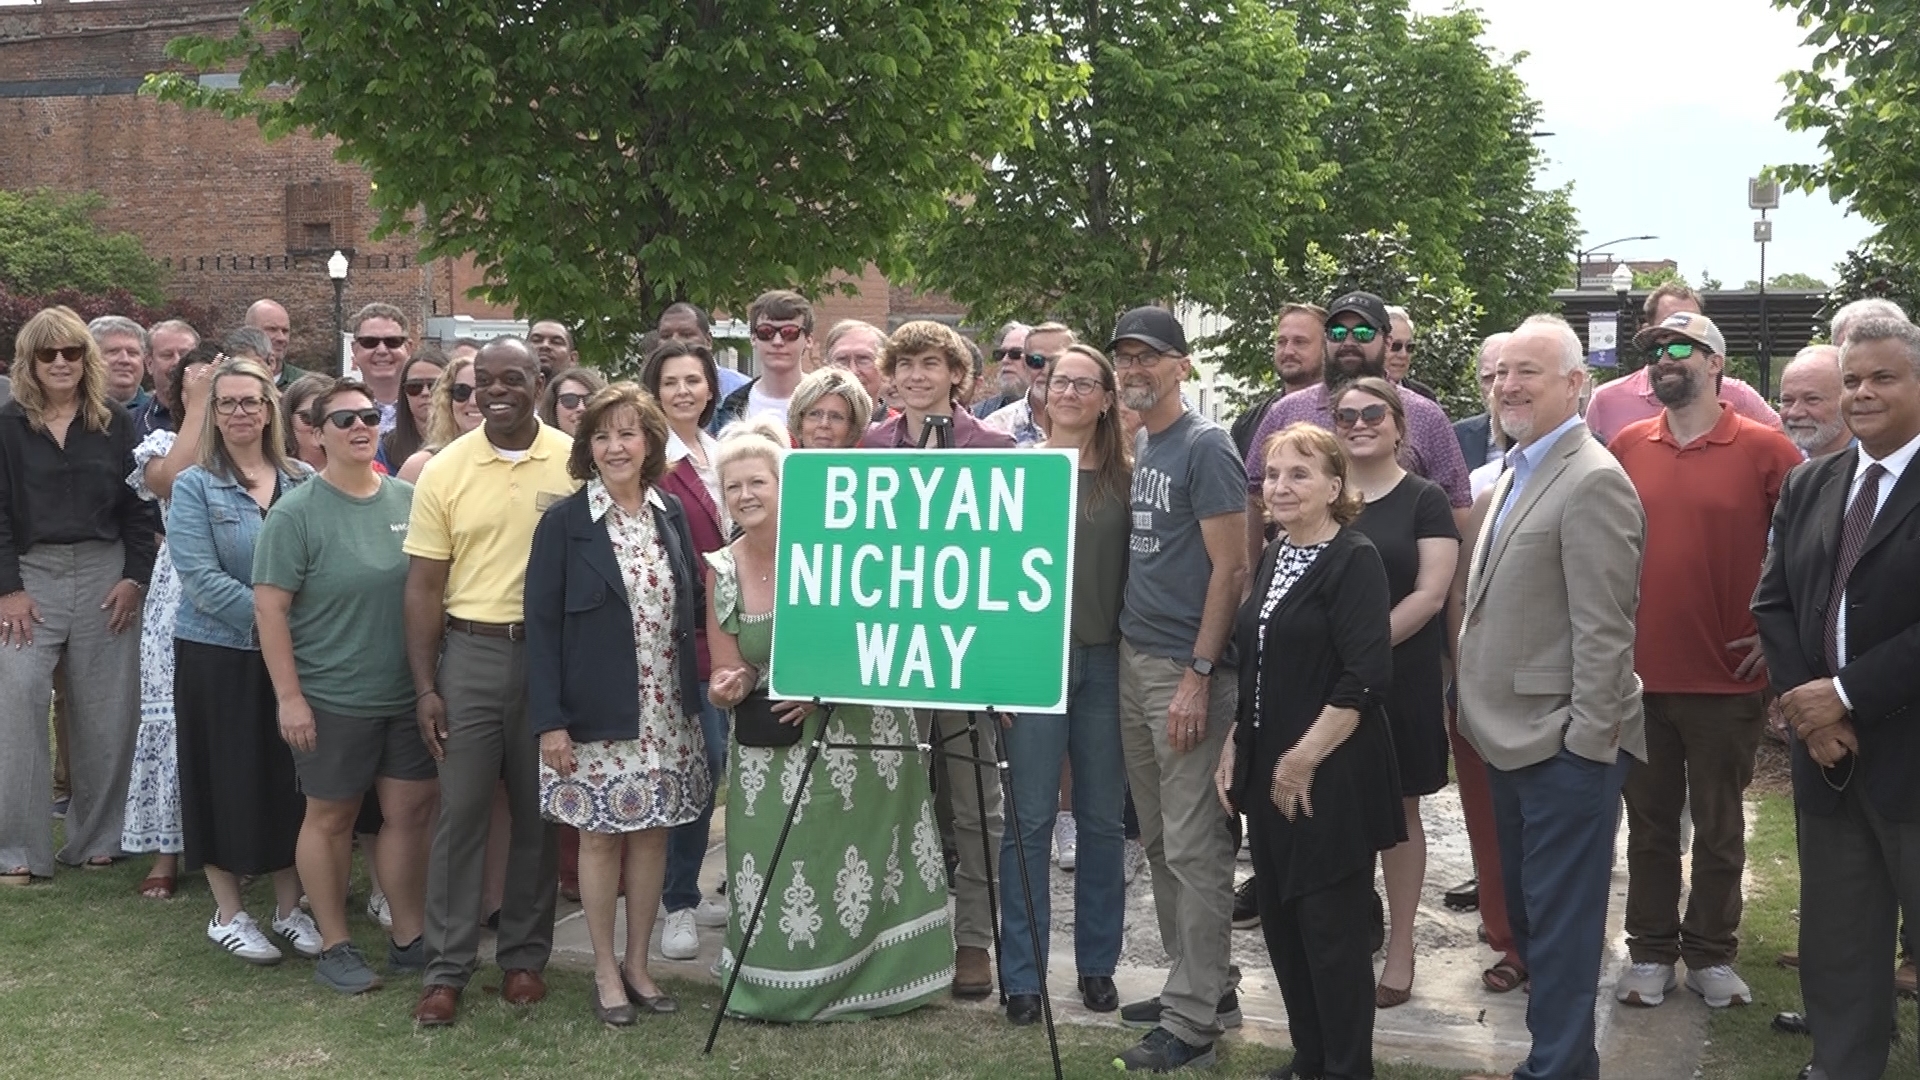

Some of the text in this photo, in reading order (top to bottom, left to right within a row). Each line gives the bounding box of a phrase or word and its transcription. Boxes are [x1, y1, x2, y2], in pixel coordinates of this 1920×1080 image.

[824, 466, 1026, 532] BRYAN
[1130, 467, 1171, 513] ACON
[788, 543, 1053, 612] NICHOLS
[855, 622, 977, 689] WAY
